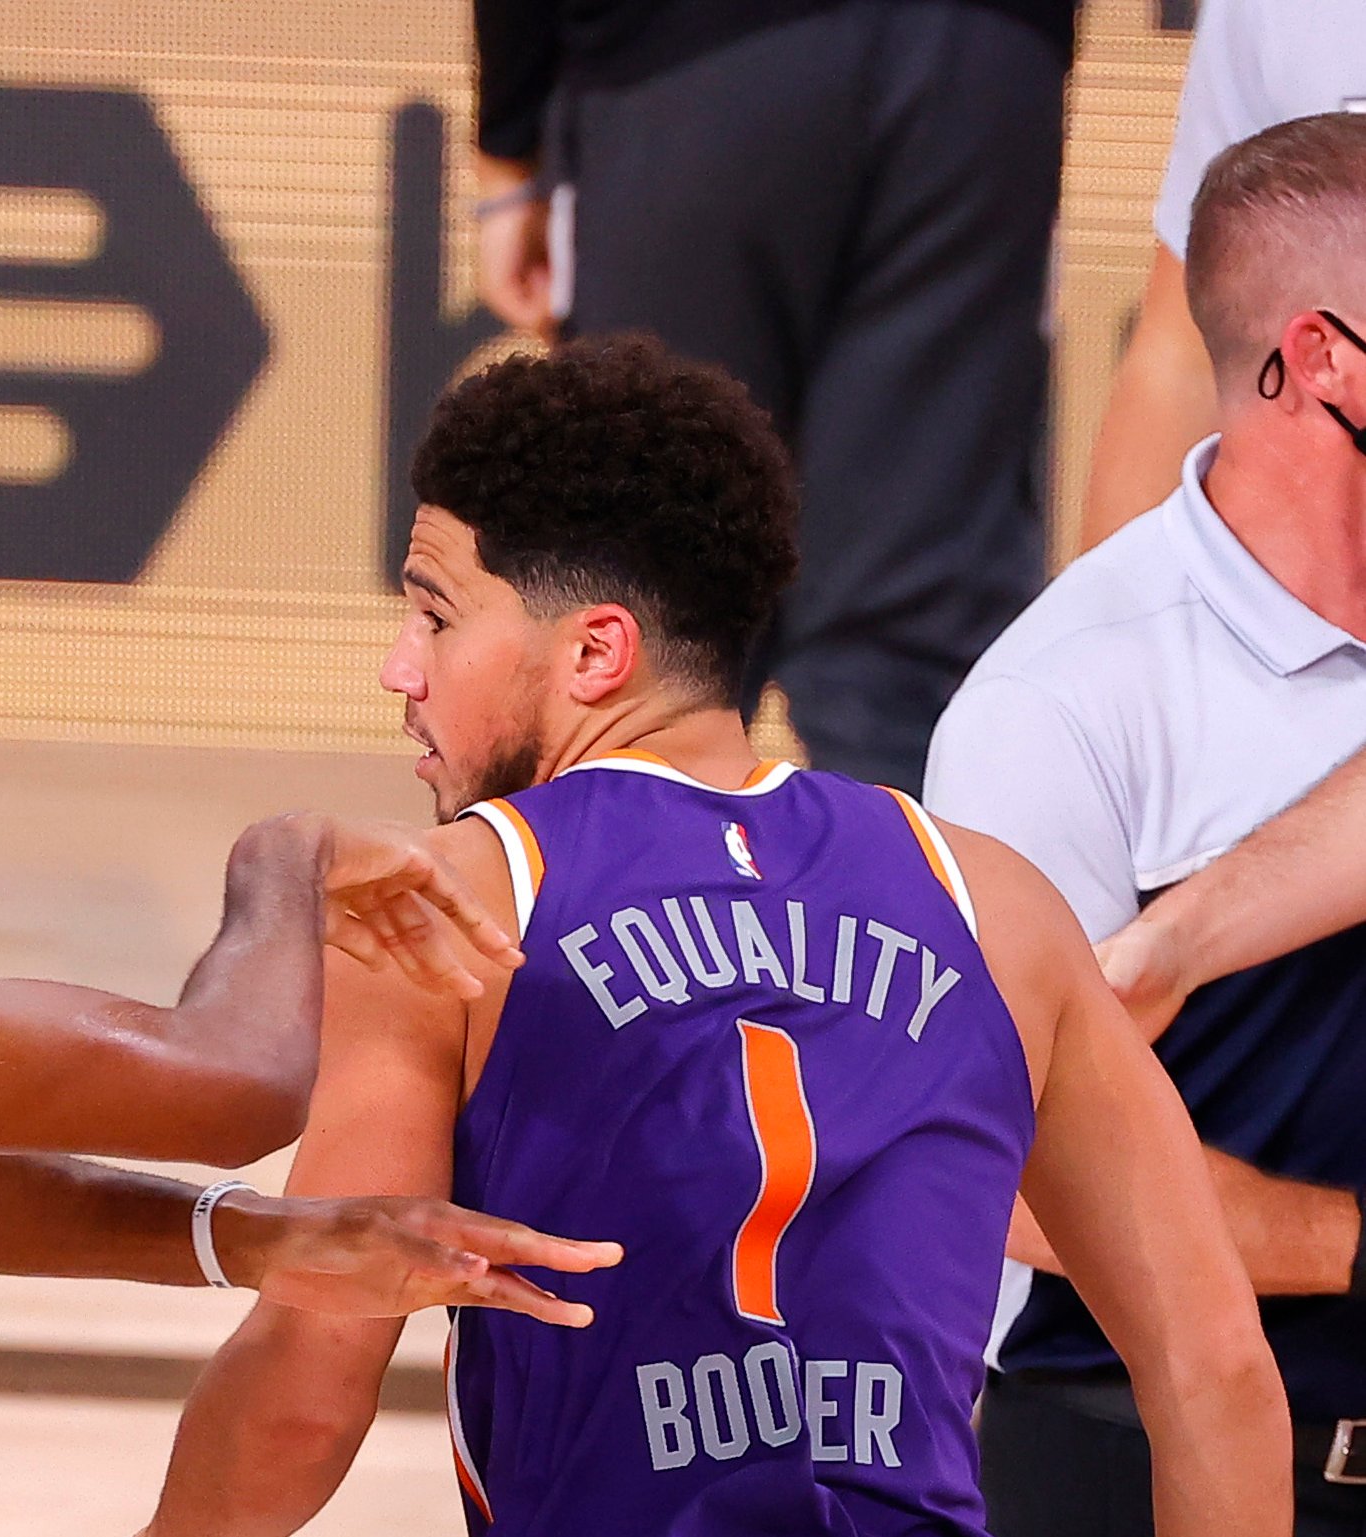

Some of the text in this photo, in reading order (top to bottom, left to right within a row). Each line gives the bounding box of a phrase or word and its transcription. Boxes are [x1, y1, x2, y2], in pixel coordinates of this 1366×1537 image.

[557, 895, 962, 1043] EQUALITY
[732, 1017, 818, 1327] 1
[635, 1340, 904, 1471] BOOER
